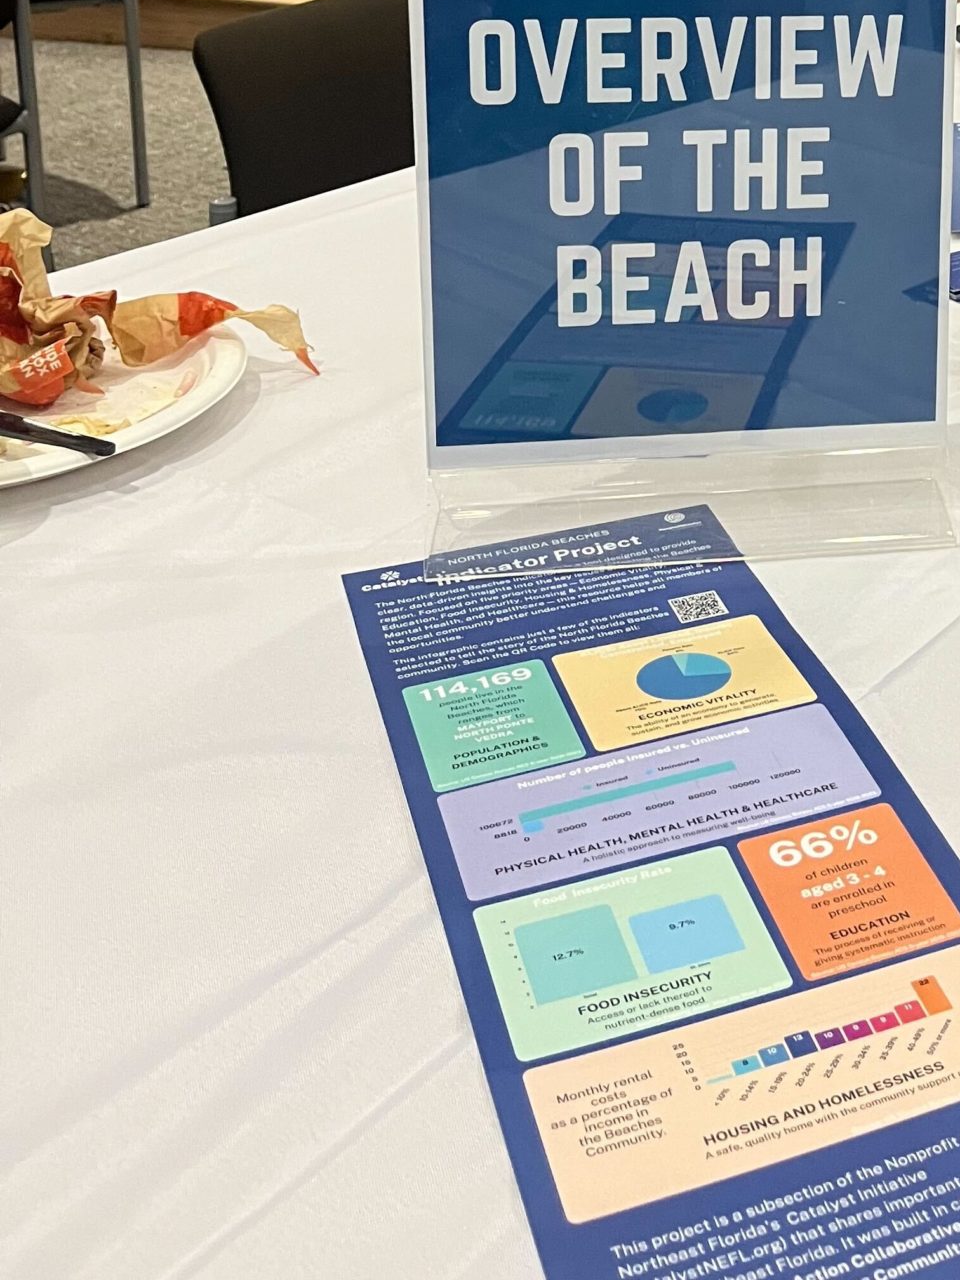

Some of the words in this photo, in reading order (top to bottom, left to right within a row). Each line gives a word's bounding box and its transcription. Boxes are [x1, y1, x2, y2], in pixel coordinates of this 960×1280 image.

[467, 14, 903, 106] OVERVIEW
[548, 130, 649, 218] OF
[682, 126, 830, 213] THE
[556, 235, 823, 328] BEACH
[448, 552, 493, 565] NORTH
[496, 542, 549, 556] FLORIDA
[552, 530, 609, 545] BEACHES
[554, 537, 641, 561] Project
[362, 576, 424, 592] Catalyst
[421, 668, 531, 701] 114,169
[639, 702, 703, 720] ECONOMIC
[706, 689, 756, 704] VITALITY
[452, 743, 548, 769] DEMOGRAPHICS
[454, 738, 529, 760] POPULATION
[517, 773, 566, 789] Number
[569, 768, 581, 776] of
[584, 759, 625, 773] people
[626, 746, 671, 762] Insured
[691, 727, 750, 746] Uninsured
[495, 853, 563, 875] PHYSICAL
[568, 837, 627, 857] HEALTH,
[629, 823, 684, 841] MENTAL
[687, 808, 739, 826] HEALTH
[753, 783, 837, 809] HEALTHCARE
[770, 821, 877, 866] 66%
[801, 877, 845, 898] aged
[846, 873, 860, 884] 3
[873, 866, 886, 876] 4
[805, 871, 817, 880] of
[820, 859, 868, 876] children
[811, 900, 830, 909] are
[833, 884, 882, 903] enrolled
[828, 895, 887, 919] preschool
[830, 911, 910, 940] EDUCATION
[553, 950, 584, 961] 12.7%
[578, 998, 620, 1015] FOOD
[624, 972, 711, 1002] INSECURITY
[557, 1084, 610, 1104] Monthly
[614, 1070, 652, 1087] rental
[591, 1091, 627, 1106] costs
[704, 1116, 779, 1145] HOUSING
[784, 1104, 816, 1121] AND
[819, 1062, 944, 1109] HOMELESSNESS
[551, 1120, 567, 1130] as
[570, 1117, 578, 1125] a
[582, 1095, 657, 1123] percentage
[660, 1088, 672, 1098] of
[584, 1114, 633, 1133] income
[636, 1108, 649, 1118] in
[579, 1135, 601, 1147] the
[604, 1118, 662, 1139] Beaches
[586, 1130, 663, 1157] Community.
[610, 1240, 648, 1258] This
[652, 1220, 711, 1249] project
[713, 1213, 729, 1226] is
[732, 1211, 742, 1220] a
[746, 1182, 833, 1215] subsection
[836, 1172, 852, 1185] of
[856, 1162, 883, 1178] the
[885, 1138, 959, 1170] Nonprofit
[618, 1244, 705, 1278] Northeast
[708, 1221, 780, 1250] Florida's
[787, 1194, 856, 1225] Catalyst
[858, 1171, 927, 1201] Initiative
[776, 1244, 839, 1272] Florida.
[840, 1236, 855, 1250] It
[857, 1226, 891, 1244] was
[892, 1210, 930, 1231] built
[931, 1204, 949, 1217] in
[790, 1225, 825, 1245] that
[829, 1207, 882, 1232] shares
